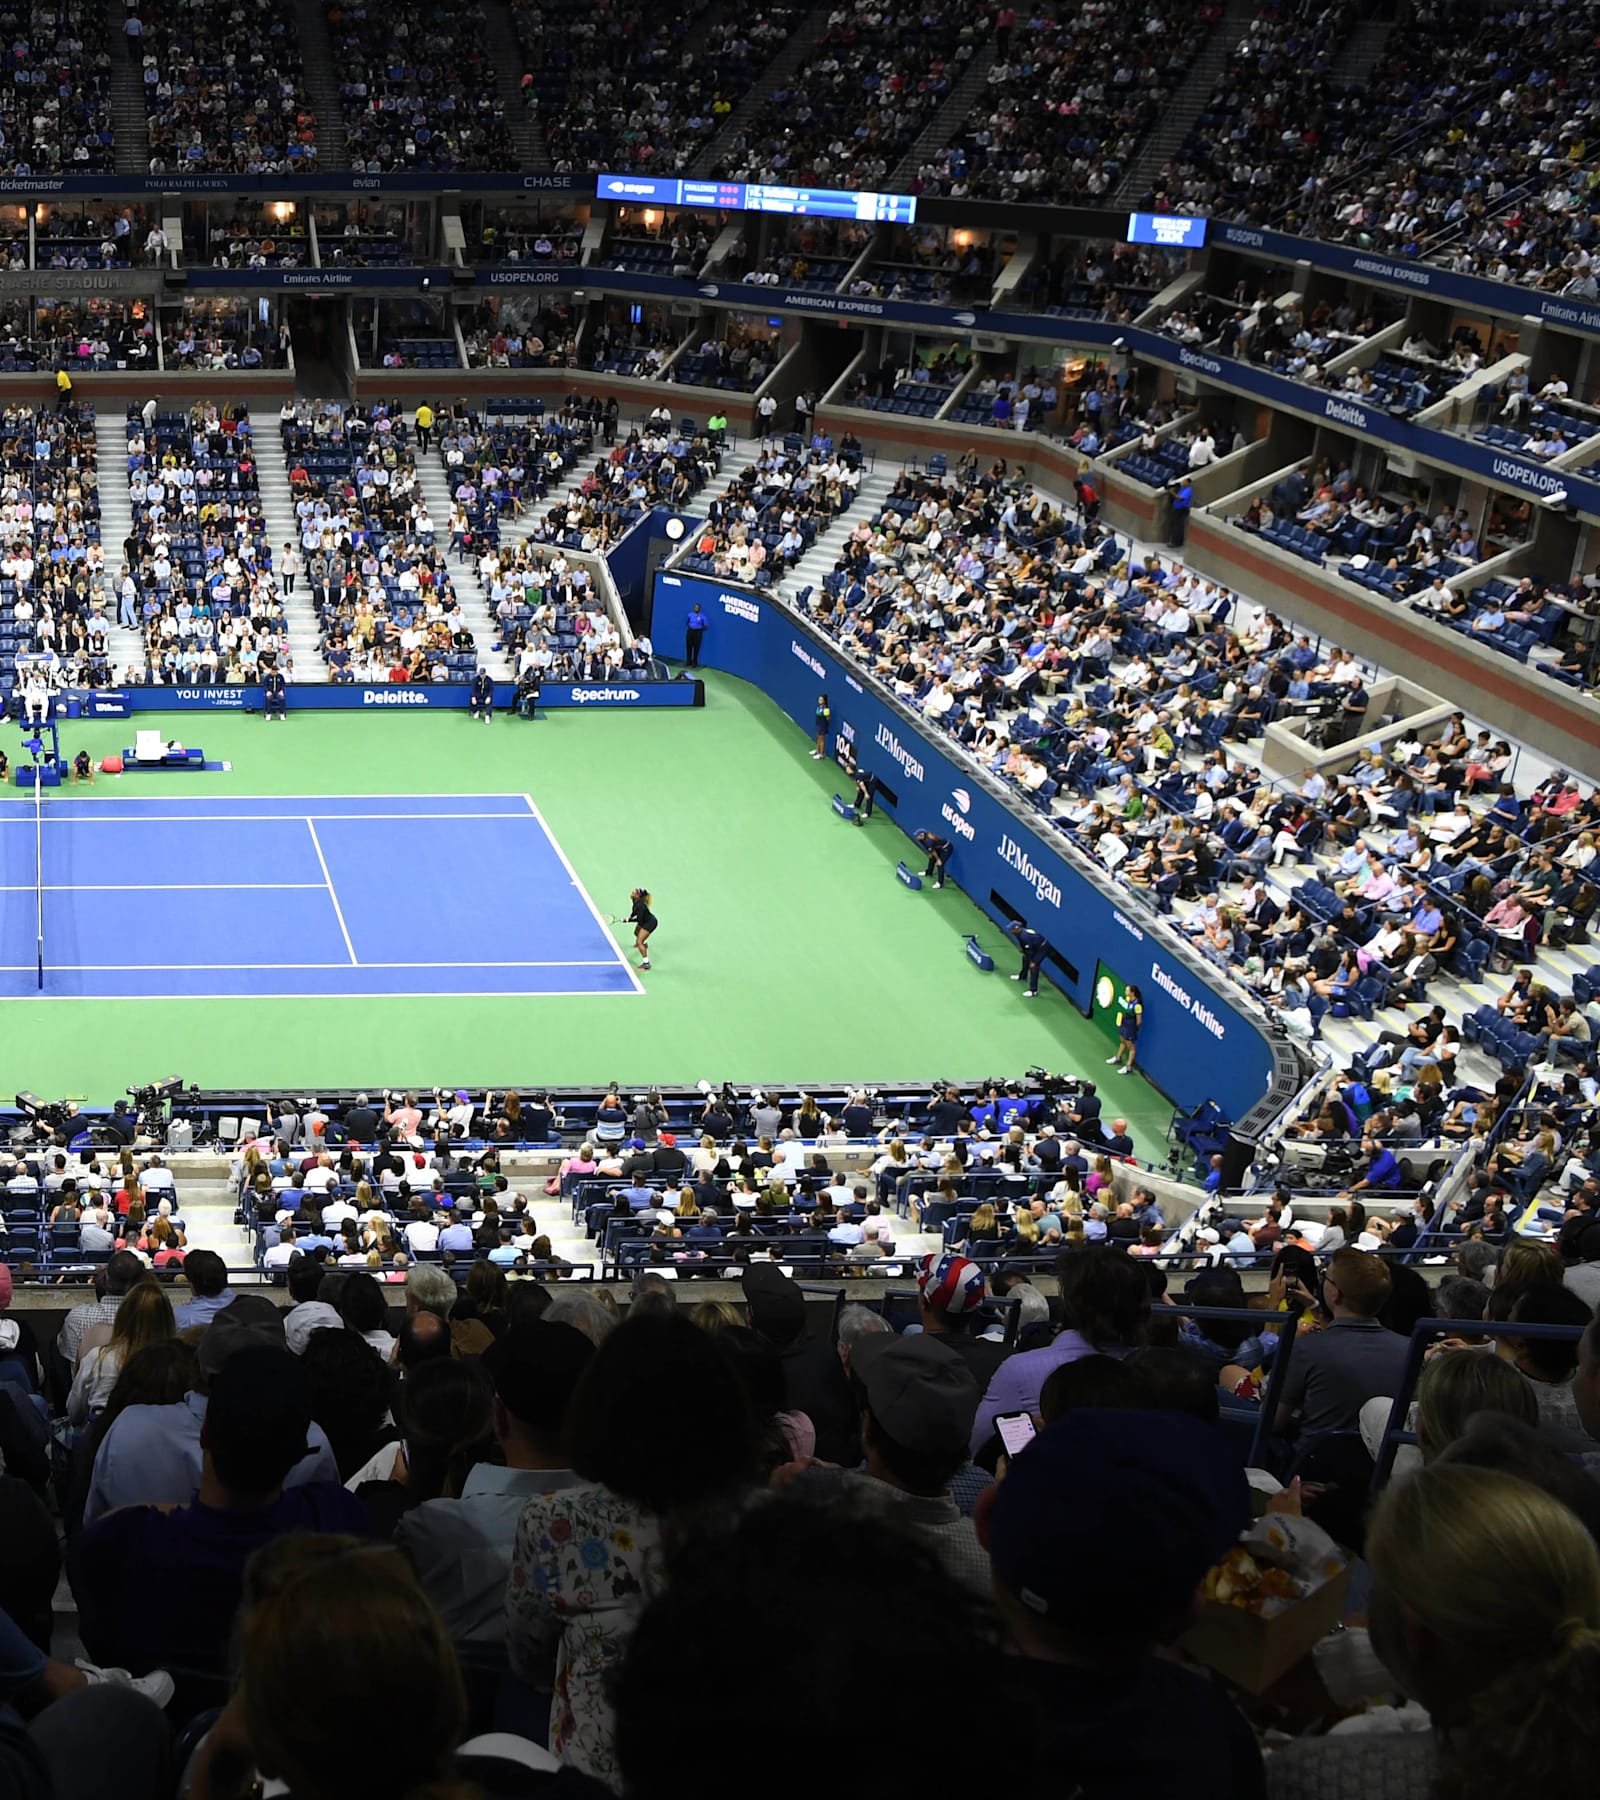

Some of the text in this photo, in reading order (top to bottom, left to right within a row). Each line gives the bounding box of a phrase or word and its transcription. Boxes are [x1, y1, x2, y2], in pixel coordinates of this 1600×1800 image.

[0, 178, 64, 190] ticketmaster
[353, 177, 380, 188] evian
[524, 176, 571, 187] CHASE
[1226, 228, 1264, 247] #USOPEN
[13, 274, 50, 288] ASHE
[54, 273, 121, 288] STADIUM
[283, 272, 353, 283] Emirates Airline
[490, 271, 560, 283] USOPEN.ORG
[1353, 257, 1430, 285] AMERICAN EXPRESS
[784, 295, 884, 314] AMERICAN EXPRESS
[1541, 302, 1578, 322] Emirates
[1179, 348, 1218, 373] Spectrum
[1326, 399, 1367, 428] Deloitte.
[1493, 458, 1565, 493] USOPEN.ORG
[719, 593, 760, 615] AMERICAN
[724, 603, 760, 624] EXPRESS
[176, 690, 243, 699] YOU INVEST
[363, 690, 429, 704] Deloitte.
[570, 688, 633, 704] Spectrum
[836, 734, 851, 759] 104
[874, 723, 924, 783] J.P.Morgan
[941, 803, 976, 841] us open
[997, 833, 1062, 909] J.P.Morgan
[1151, 962, 1226, 1040] Emirates Airline
